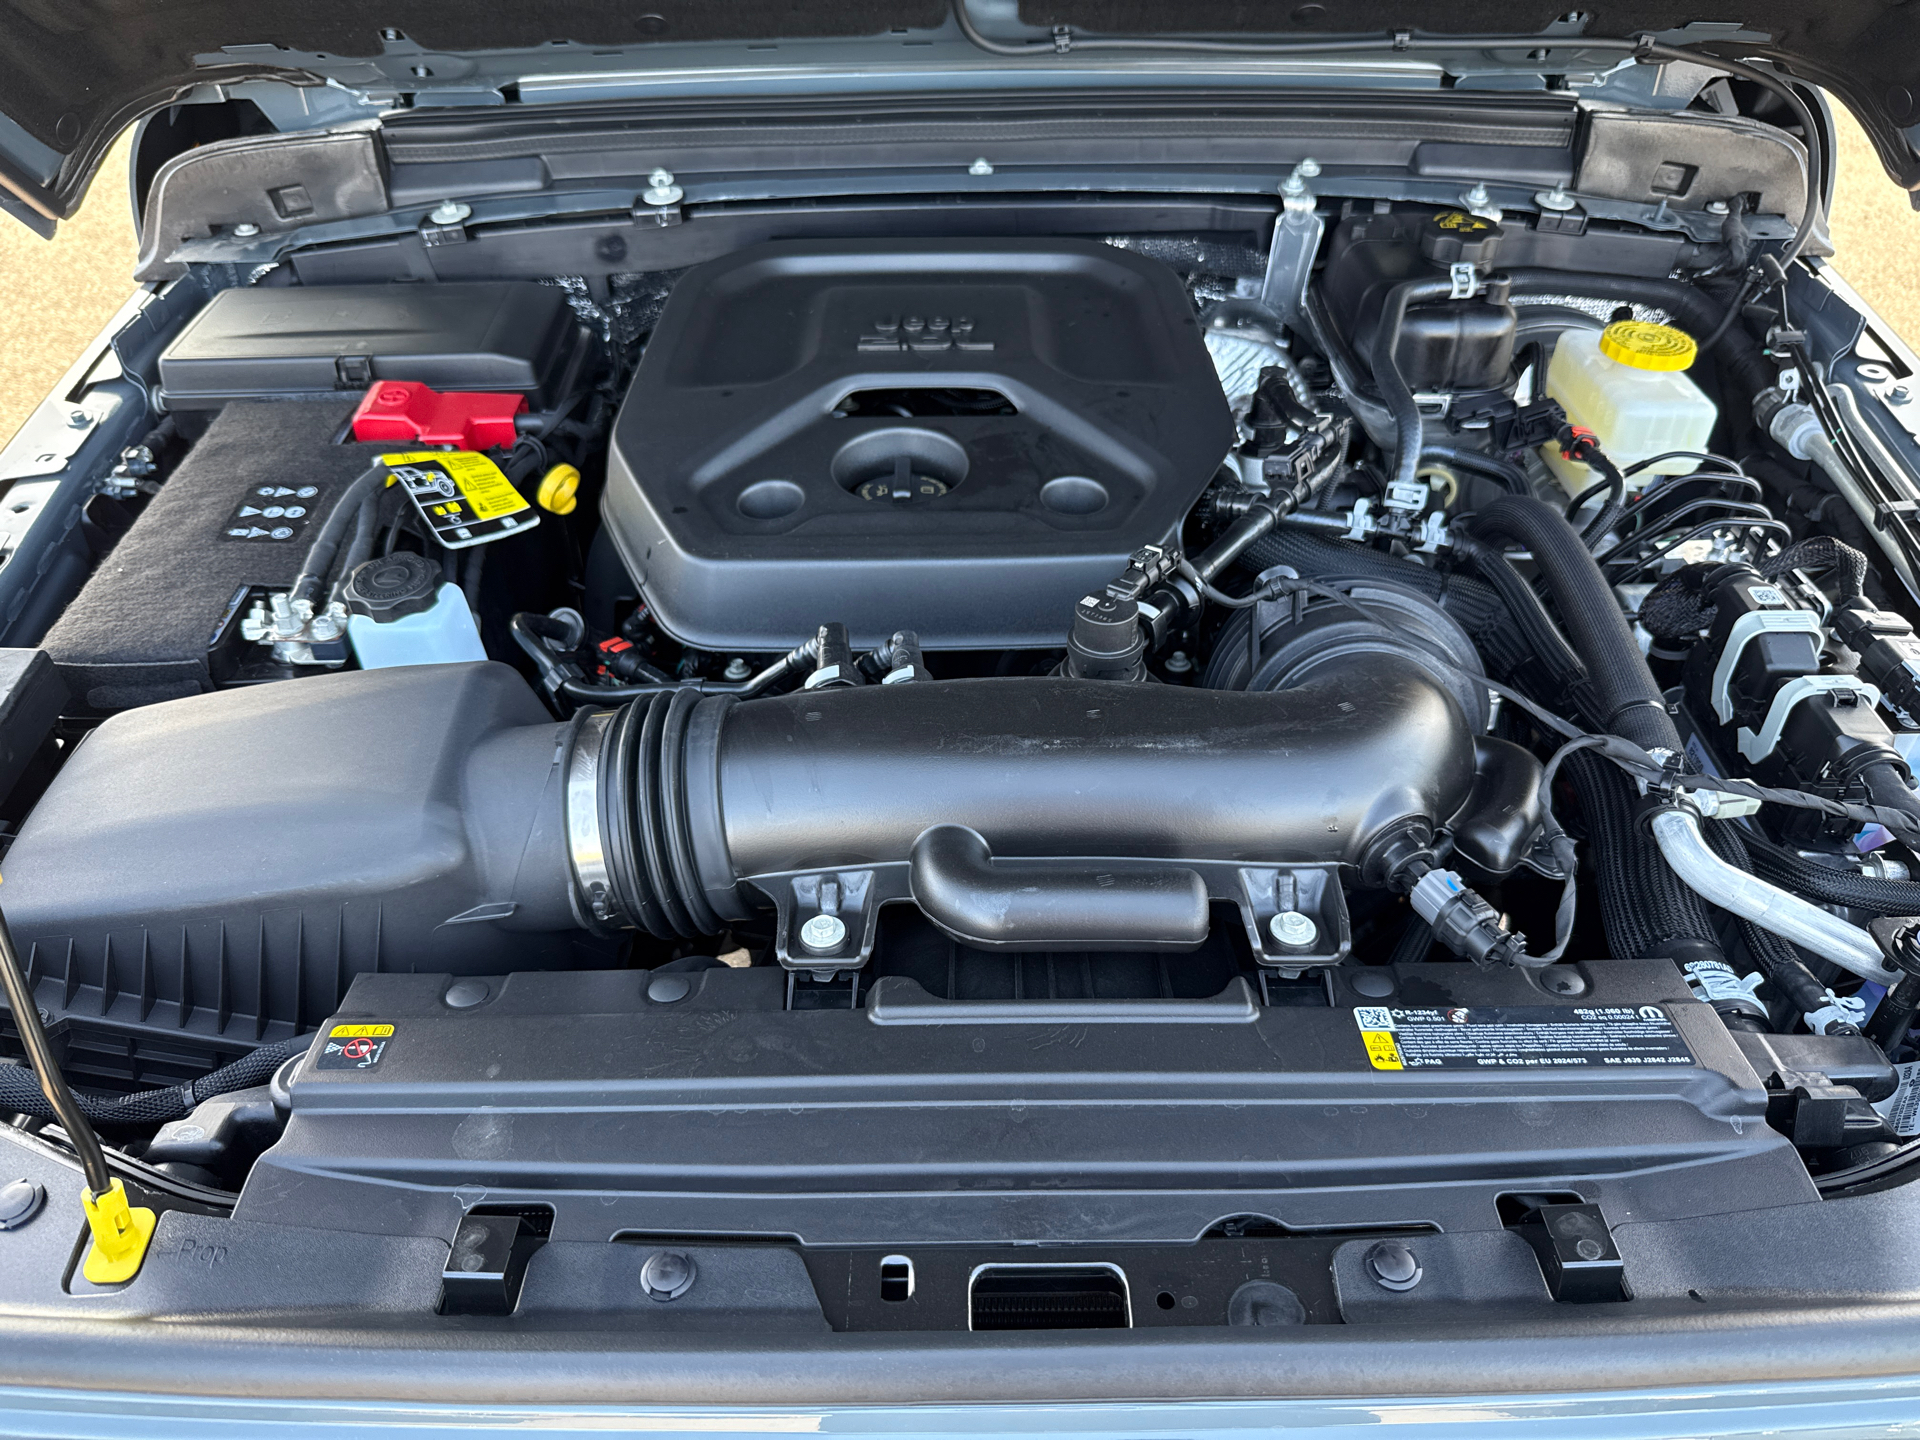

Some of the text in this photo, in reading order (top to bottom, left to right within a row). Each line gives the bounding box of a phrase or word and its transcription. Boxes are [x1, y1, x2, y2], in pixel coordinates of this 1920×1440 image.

[874, 313, 975, 336] Jeep
[1525, 1058, 1539, 1066] per
[178, 1239, 228, 1269] Prop
